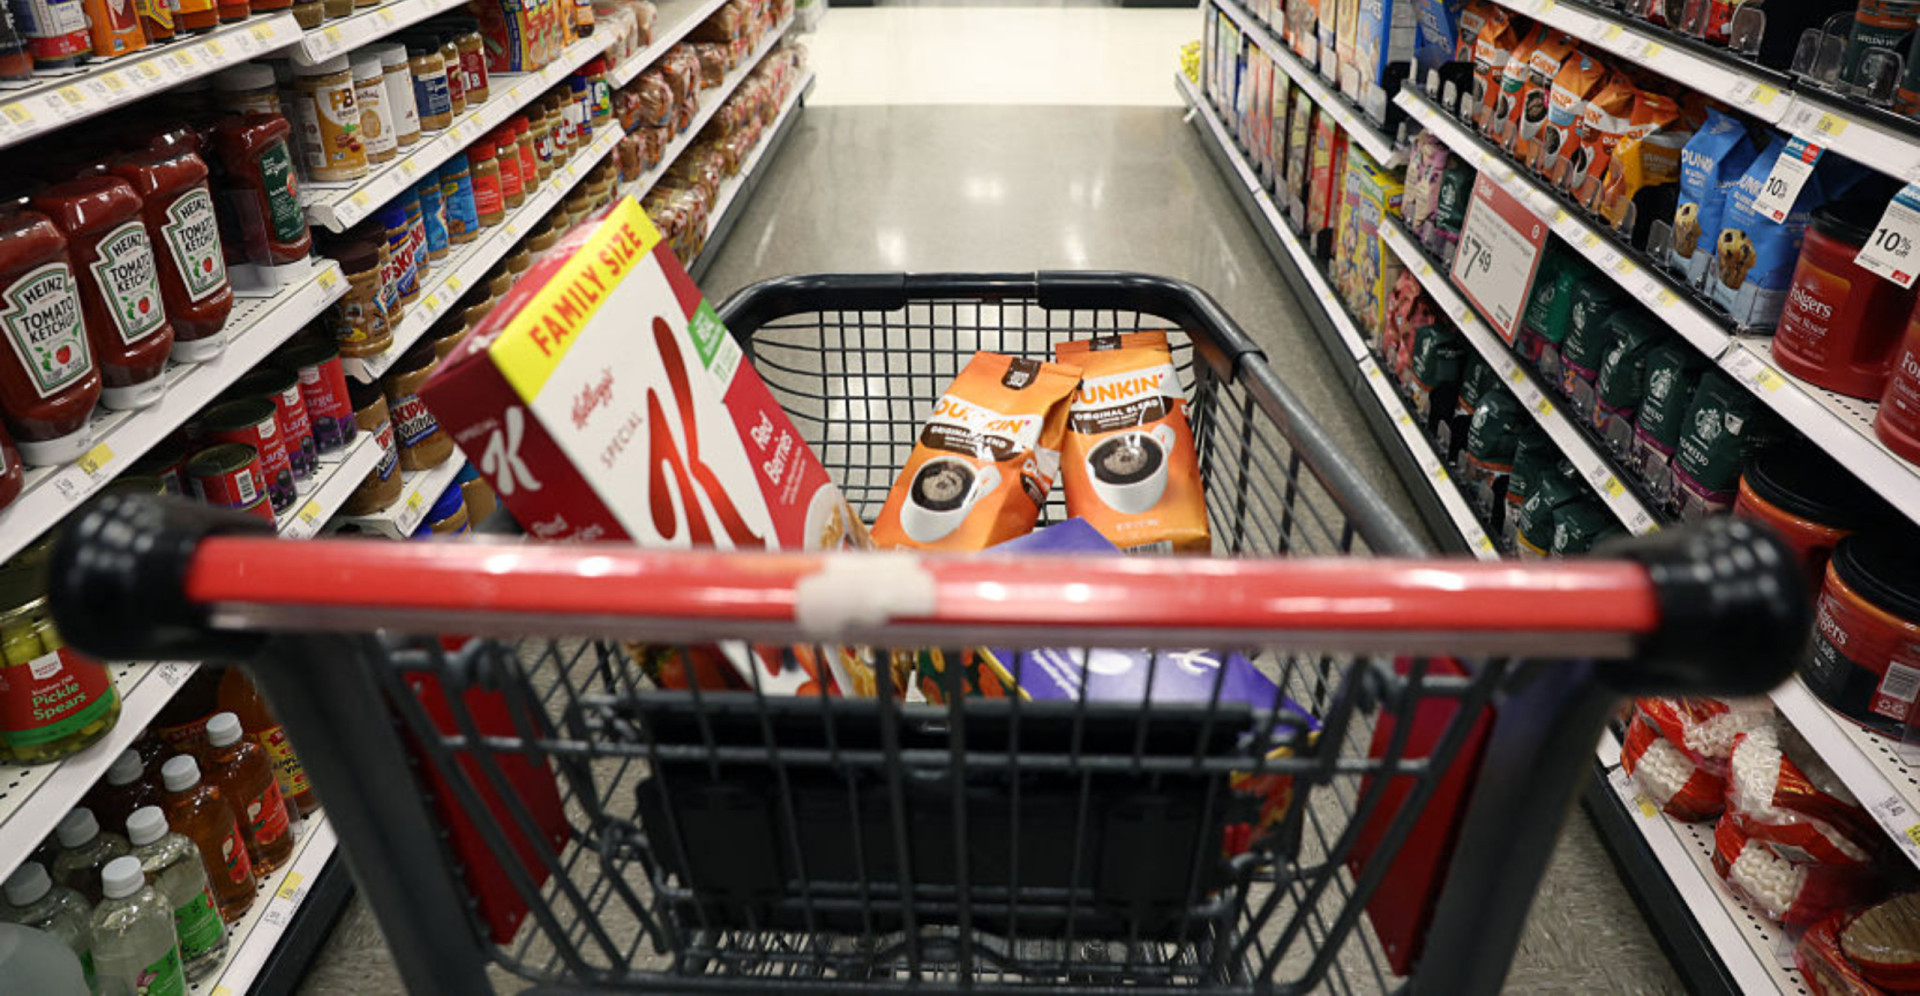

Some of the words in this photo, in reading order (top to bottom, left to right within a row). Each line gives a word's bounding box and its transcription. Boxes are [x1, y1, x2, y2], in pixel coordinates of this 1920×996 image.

[180, 198, 207, 219] HEINZ
[111, 233, 142, 257] HEINZ
[23, 277, 63, 304] HEINZ
[528, 264, 606, 358] FAMILY
[597, 222, 642, 277] SIZE
[20, 296, 74, 333] TOMATO
[29, 311, 75, 344] KETCHUP
[600, 411, 643, 469] SPECIAL
[751, 409, 774, 451] Red
[480, 406, 543, 495] K
[763, 429, 793, 486] Berries
[32, 682, 80, 708] Pickle
[33, 691, 87, 720] Spears
